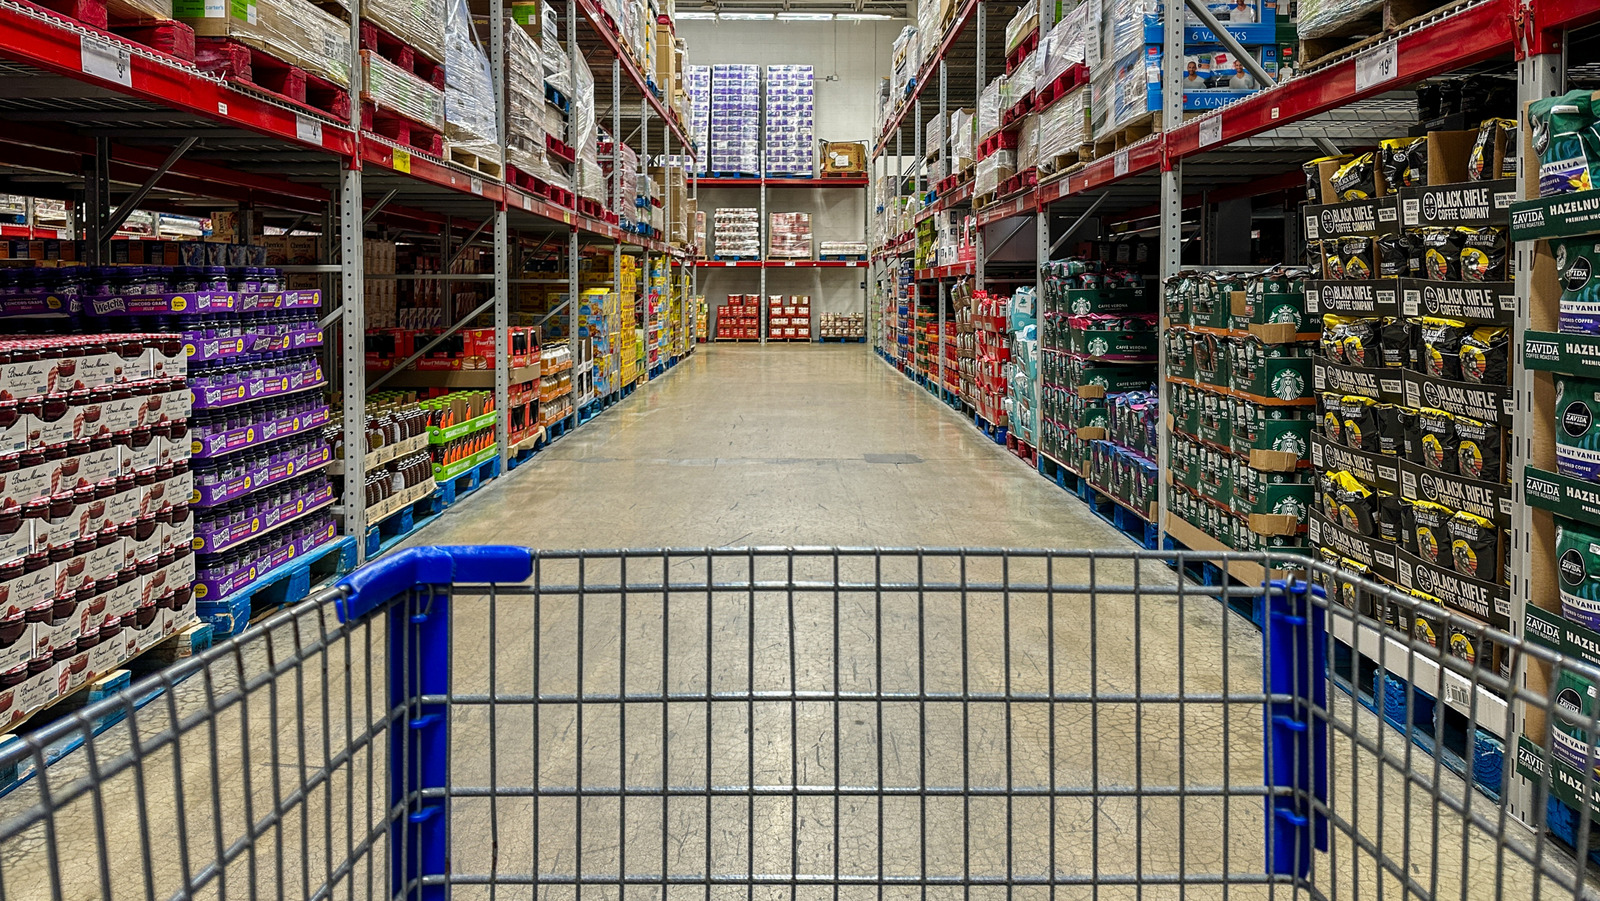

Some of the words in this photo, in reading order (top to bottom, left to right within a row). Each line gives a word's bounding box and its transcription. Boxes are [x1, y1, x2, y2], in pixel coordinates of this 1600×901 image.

[1192, 31, 1198, 40] 6
[1194, 97, 1200, 106] 6
[1436, 190, 1462, 208] BLACK
[1463, 188, 1488, 206] RIFLE
[1332, 208, 1353, 222] BLACK
[1353, 205, 1374, 220] RIFLE
[1438, 208, 1459, 220] COFFEE
[1460, 206, 1490, 220] COMPANY
[1550, 198, 1600, 216] HAZELNU
[1512, 211, 1544, 224] ZAVIDA
[1566, 215, 1589, 224] PREMIUM
[1335, 222, 1352, 233] COFFEE
[1352, 220, 1376, 232] COMPANY
[1333, 286, 1354, 300] BLACK
[1354, 286, 1373, 300] RIFLE
[1436, 288, 1465, 305] BLACK
[1465, 289, 1494, 306] RIFLE
[94, 298, 124, 313] Welch's
[1336, 300, 1352, 310] COFFEE
[1352, 300, 1374, 311] COMPANY
[1440, 304, 1462, 316] COFFEE
[1463, 306, 1494, 319] COMPANY
[1526, 343, 1559, 356] ZAVIDA
[1336, 368, 1356, 384] BLACK
[1355, 372, 1377, 388] RIFLE
[1340, 382, 1356, 394] COFFEE
[1356, 386, 1380, 398] COMPANY
[1437, 384, 1468, 405] BLACK
[1466, 390, 1496, 410] RIFLE
[1442, 401, 1466, 415] COFFEE
[1465, 406, 1498, 422] COMPANY
[1566, 414, 1587, 424] ZAVIDA
[1334, 448, 1355, 466] BLACK
[1353, 454, 1374, 472] RIFLE
[1435, 476, 1466, 500] BLACK
[1465, 484, 1494, 506] RIFLE
[1526, 479, 1560, 496] ZAVIDA
[1439, 494, 1462, 510] COFFEE
[1462, 500, 1494, 519] COMPANY
[1331, 526, 1352, 547] BLACK
[1350, 536, 1371, 557] RIFLE
[1430, 570, 1461, 596] BLACK
[1460, 580, 1488, 606] RIFLE
[1434, 586, 1457, 605] COFFEE
[1458, 596, 1489, 618] COMPANY
[1526, 616, 1560, 640] ZAVIDA
